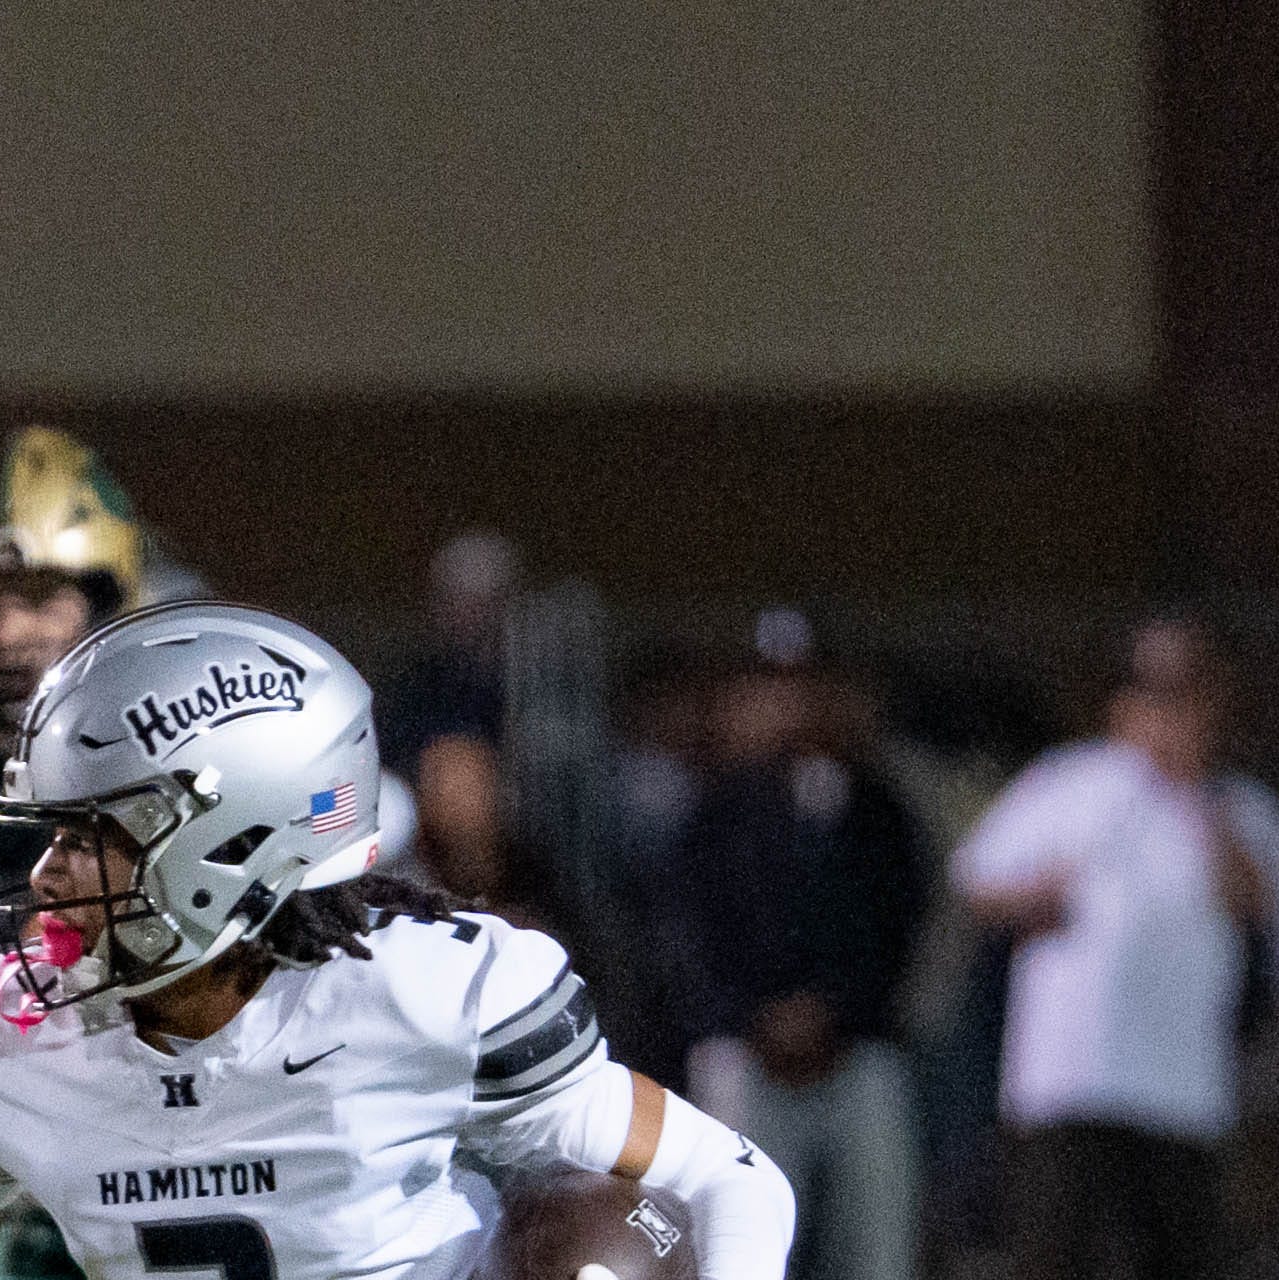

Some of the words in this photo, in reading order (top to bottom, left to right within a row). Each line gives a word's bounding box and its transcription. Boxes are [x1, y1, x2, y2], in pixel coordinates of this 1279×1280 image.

[125, 662, 304, 756] Huskies
[160, 1072, 201, 1109] H
[96, 1158, 277, 1206] HAMILTON
